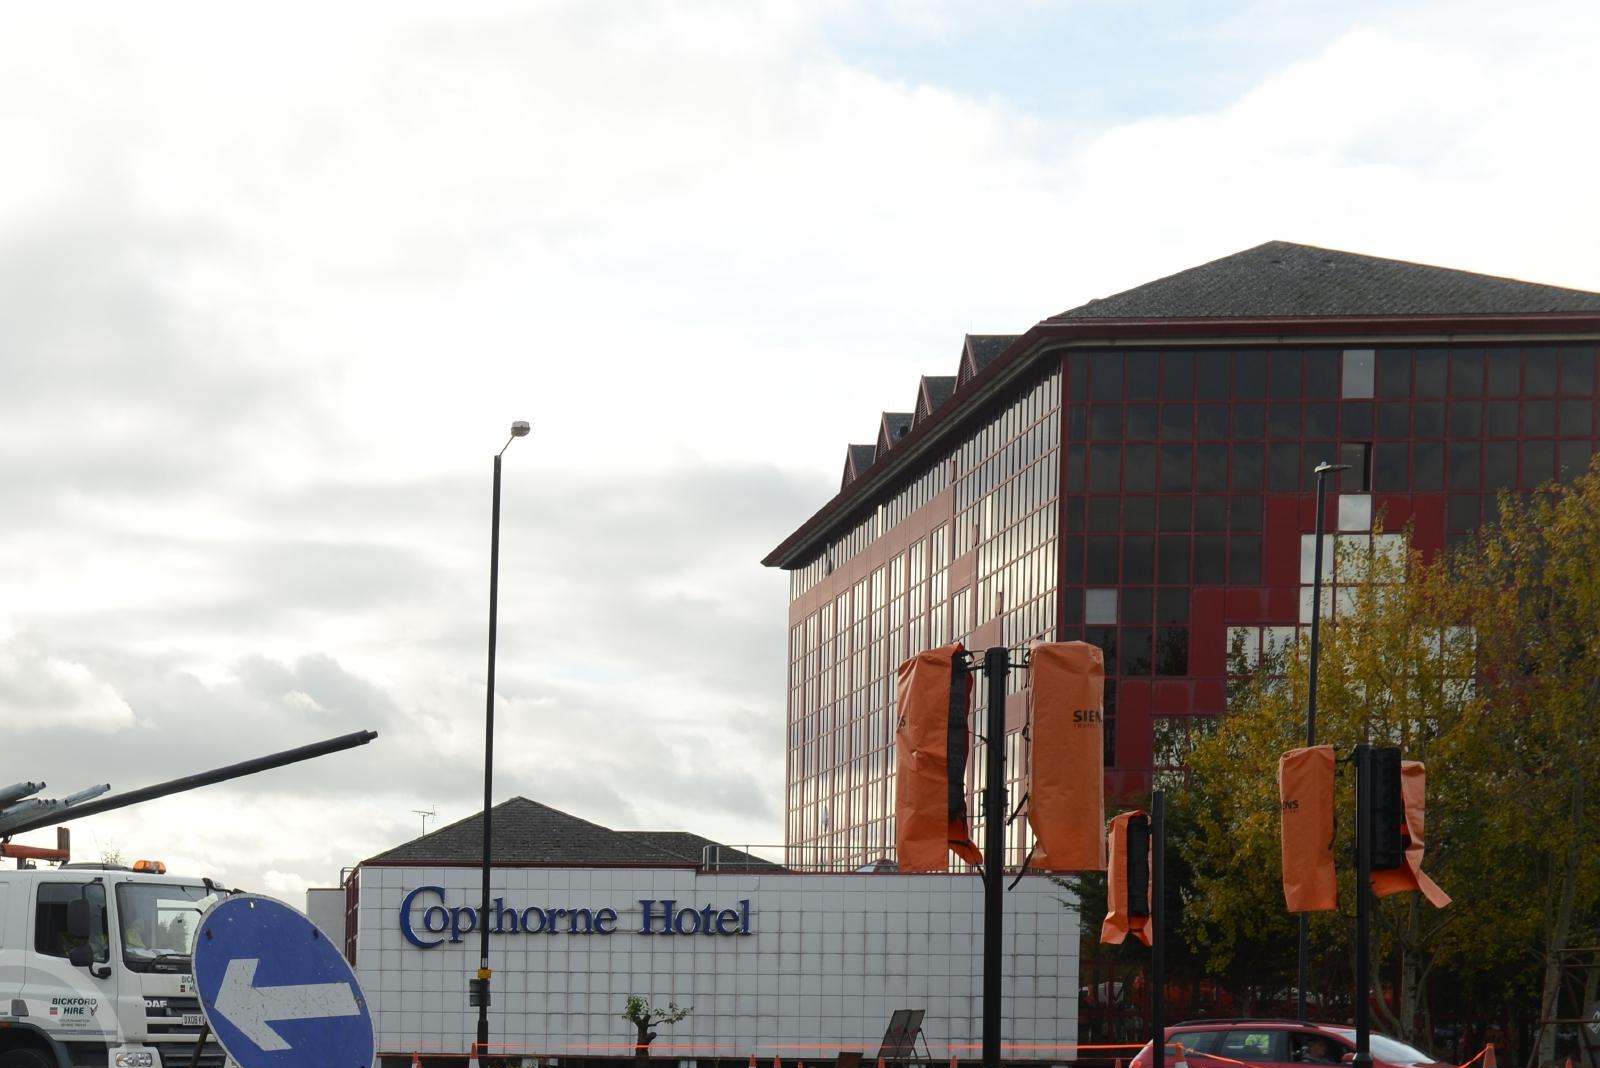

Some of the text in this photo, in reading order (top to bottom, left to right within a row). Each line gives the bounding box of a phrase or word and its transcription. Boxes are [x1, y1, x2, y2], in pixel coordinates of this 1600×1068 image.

[400, 885, 752, 949] Cophorne Hotel
[52, 997, 97, 1005] BICKFORD
[145, 1000, 167, 1008] DAF
[63, 1006, 84, 1015] HIRE
